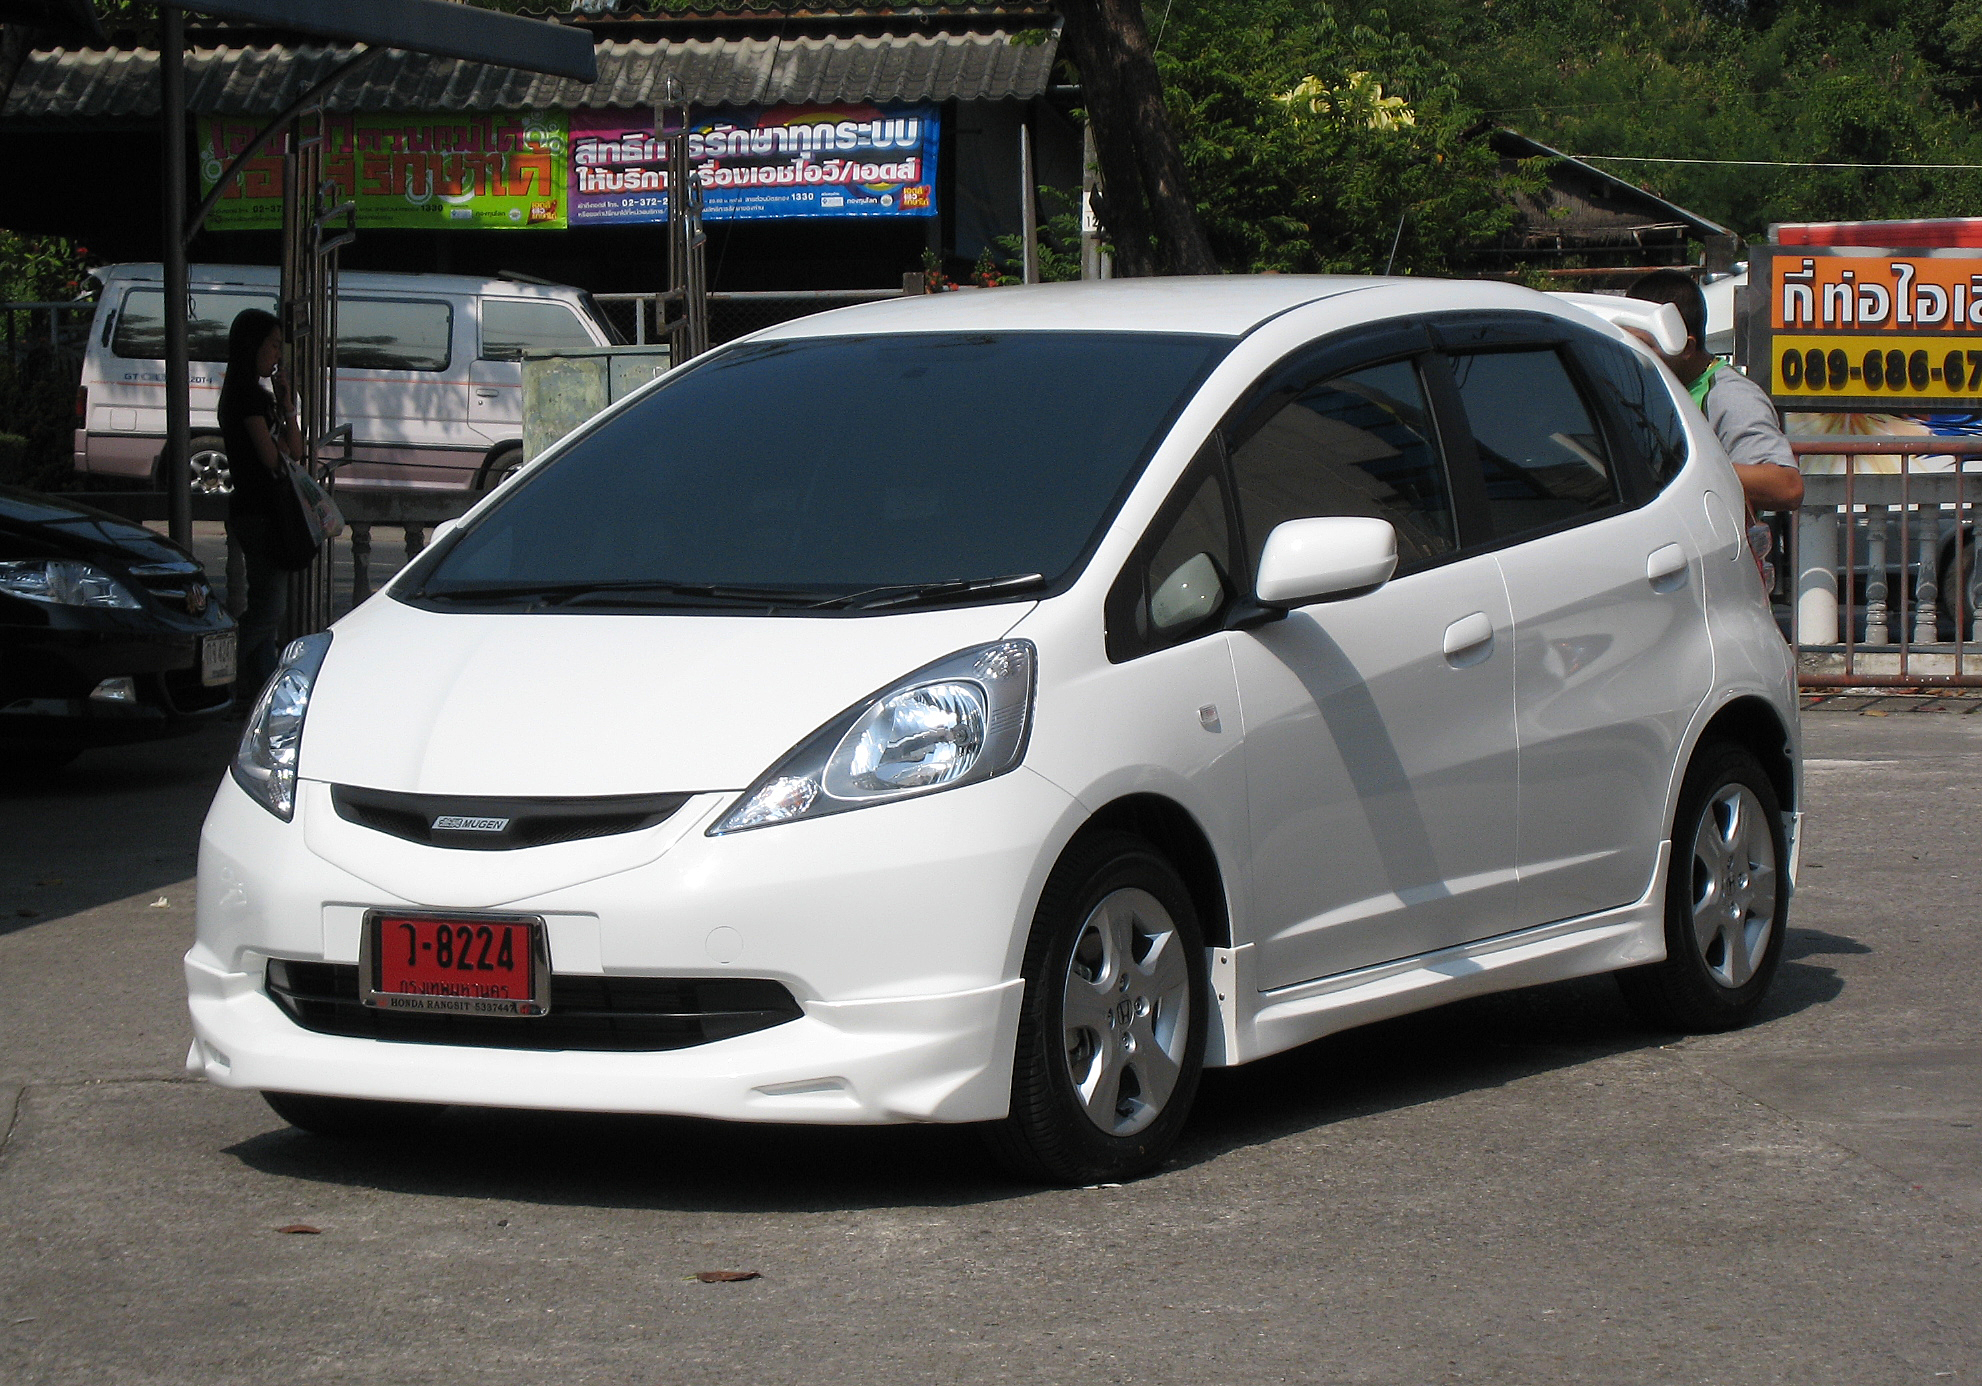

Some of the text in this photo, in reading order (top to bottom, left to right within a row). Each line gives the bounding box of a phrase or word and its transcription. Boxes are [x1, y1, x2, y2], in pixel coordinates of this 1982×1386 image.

[575, 118, 918, 165] สิทธิกรรักษาทุกระบบ
[575, 156, 916, 191] ให้บริการื่องเอชไอวี/เอดส์
[420, 204, 444, 213] 1330
[791, 192, 815, 201] 1330
[1781, 348, 1982, 393] 089-686-67
[462, 818, 504, 830] MUGEN
[399, 923, 515, 972] ว-8224
[390, 997, 424, 1009] HONDA
[427, 1000, 470, 1010] RANGSIT
